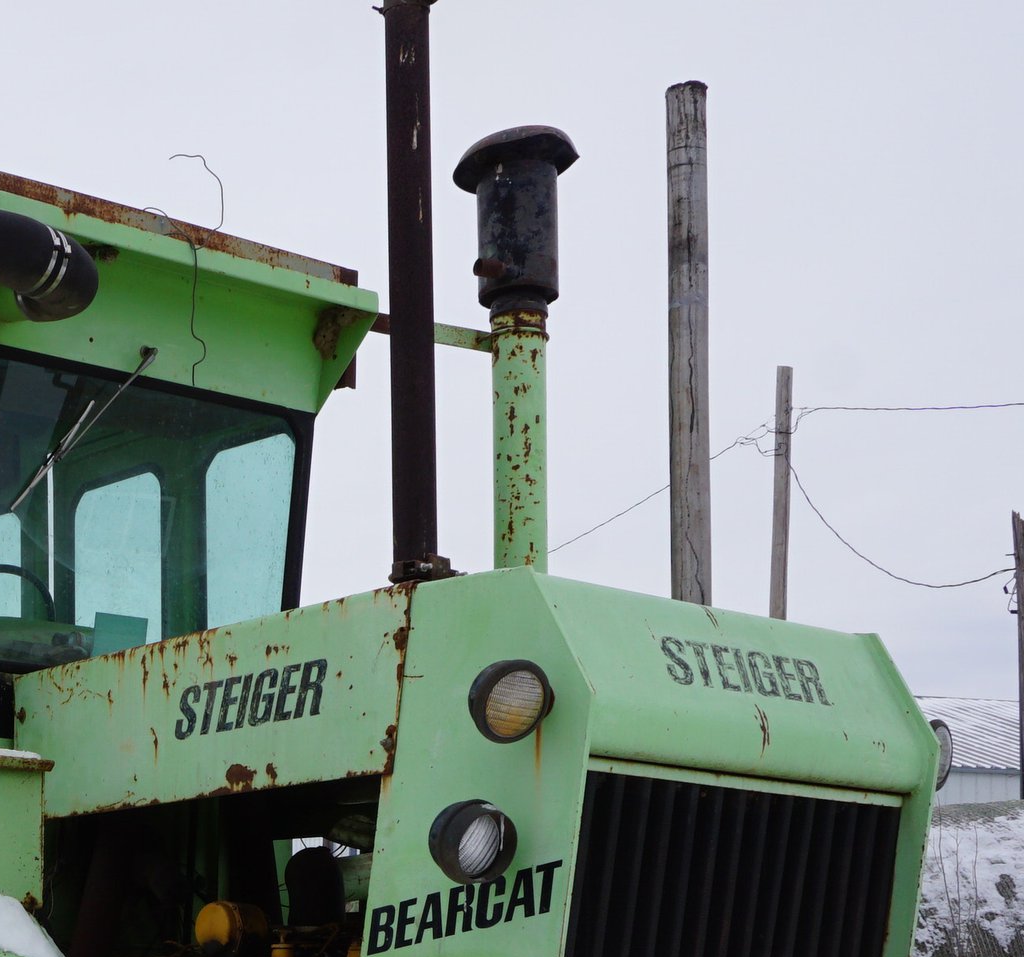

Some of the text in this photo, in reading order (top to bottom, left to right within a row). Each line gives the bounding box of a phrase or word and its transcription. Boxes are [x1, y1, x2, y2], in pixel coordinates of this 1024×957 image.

[174, 658, 328, 741] STEIGER
[660, 636, 834, 706] STEIGER
[367, 859, 563, 956] BEARCAT
